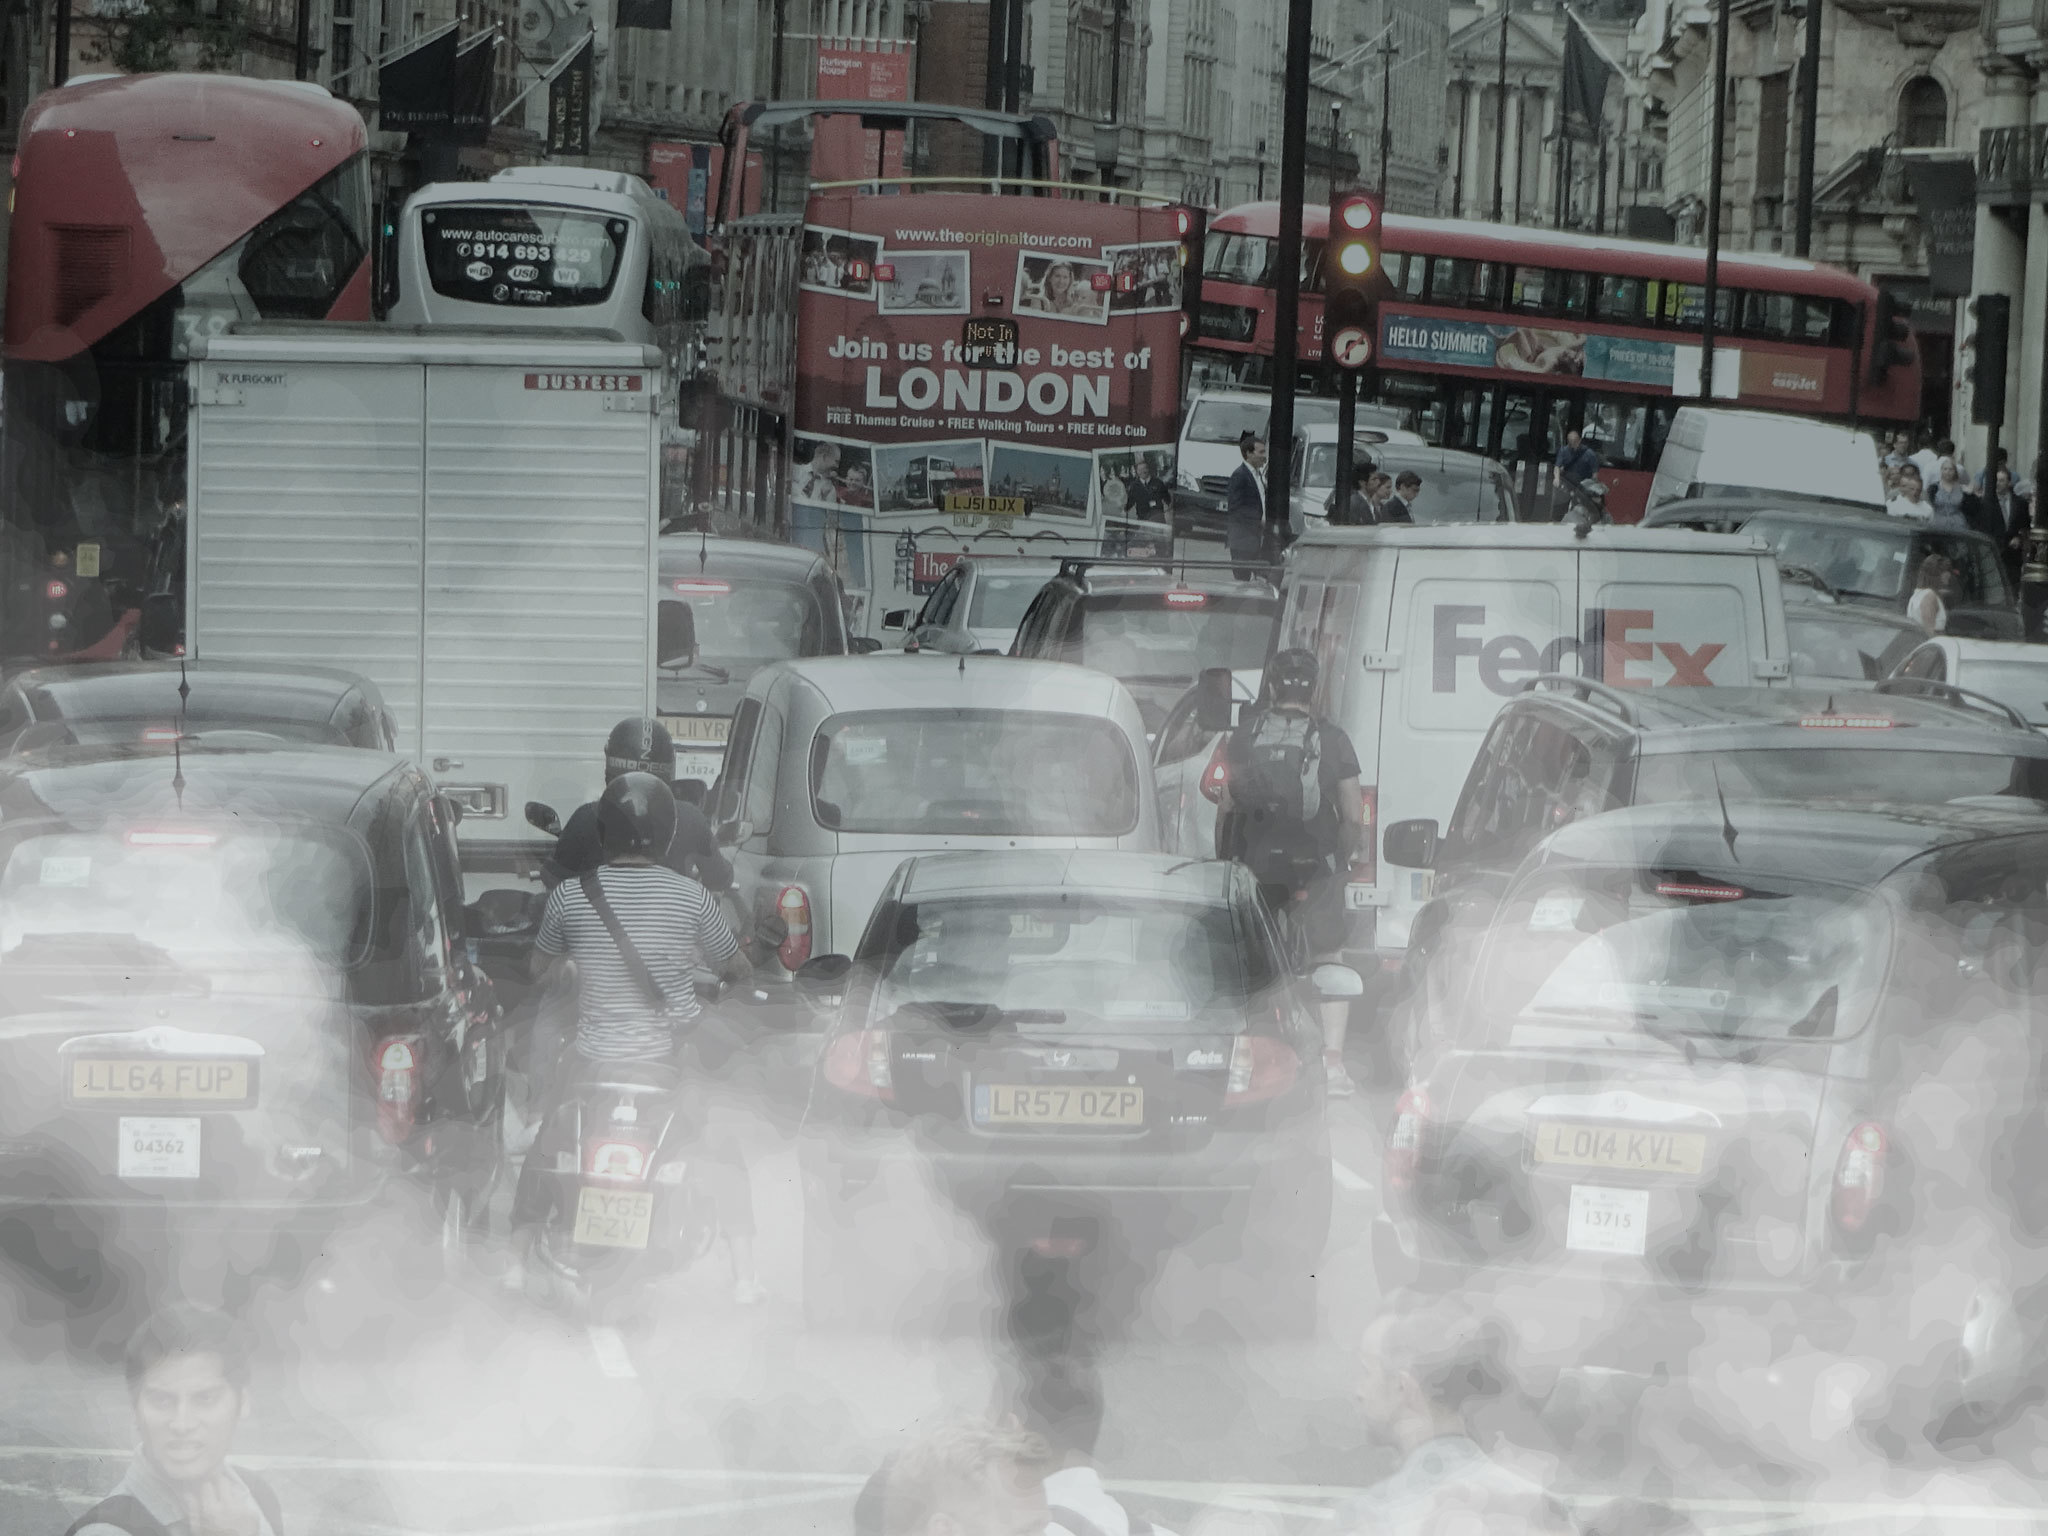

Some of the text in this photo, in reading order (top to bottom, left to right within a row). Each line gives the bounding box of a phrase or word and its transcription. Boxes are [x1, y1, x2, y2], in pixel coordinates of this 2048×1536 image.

[896, 228, 1093, 249] www.theoriginaltour.com
[474, 244, 509, 259] 914
[515, 245, 551, 261] 693
[512, 266, 539, 279] USB
[967, 323, 1014, 341] Not In
[1388, 325, 1488, 354] HELLO SUMMER
[828, 335, 888, 359] Join
[899, 344, 932, 361] us
[943, 340, 981, 364] for
[994, 342, 1040, 365] the
[1051, 344, 1114, 369] best
[1124, 347, 1151, 370] of
[538, 375, 630, 390] BUSTESE
[866, 366, 1109, 417] LONDON
[1384, 378, 1392, 391] 9
[827, 413, 1147, 438] FREE Thames Cruise FREE Walking Tours FREE Kids Club
[953, 497, 1016, 512] LJ51 DJX
[922, 553, 949, 577] The
[1432, 604, 1728, 699] FedEx
[88, 1065, 234, 1092] LL64 FUP
[993, 1089, 1138, 1119] LR57 OZP
[134, 1139, 185, 1154] 04362
[1553, 1127, 1683, 1166] LO14 KVL
[581, 1194, 647, 1217] LY65
[586, 1215, 637, 1239] FZV
[1585, 1210, 1632, 1229] 13715
